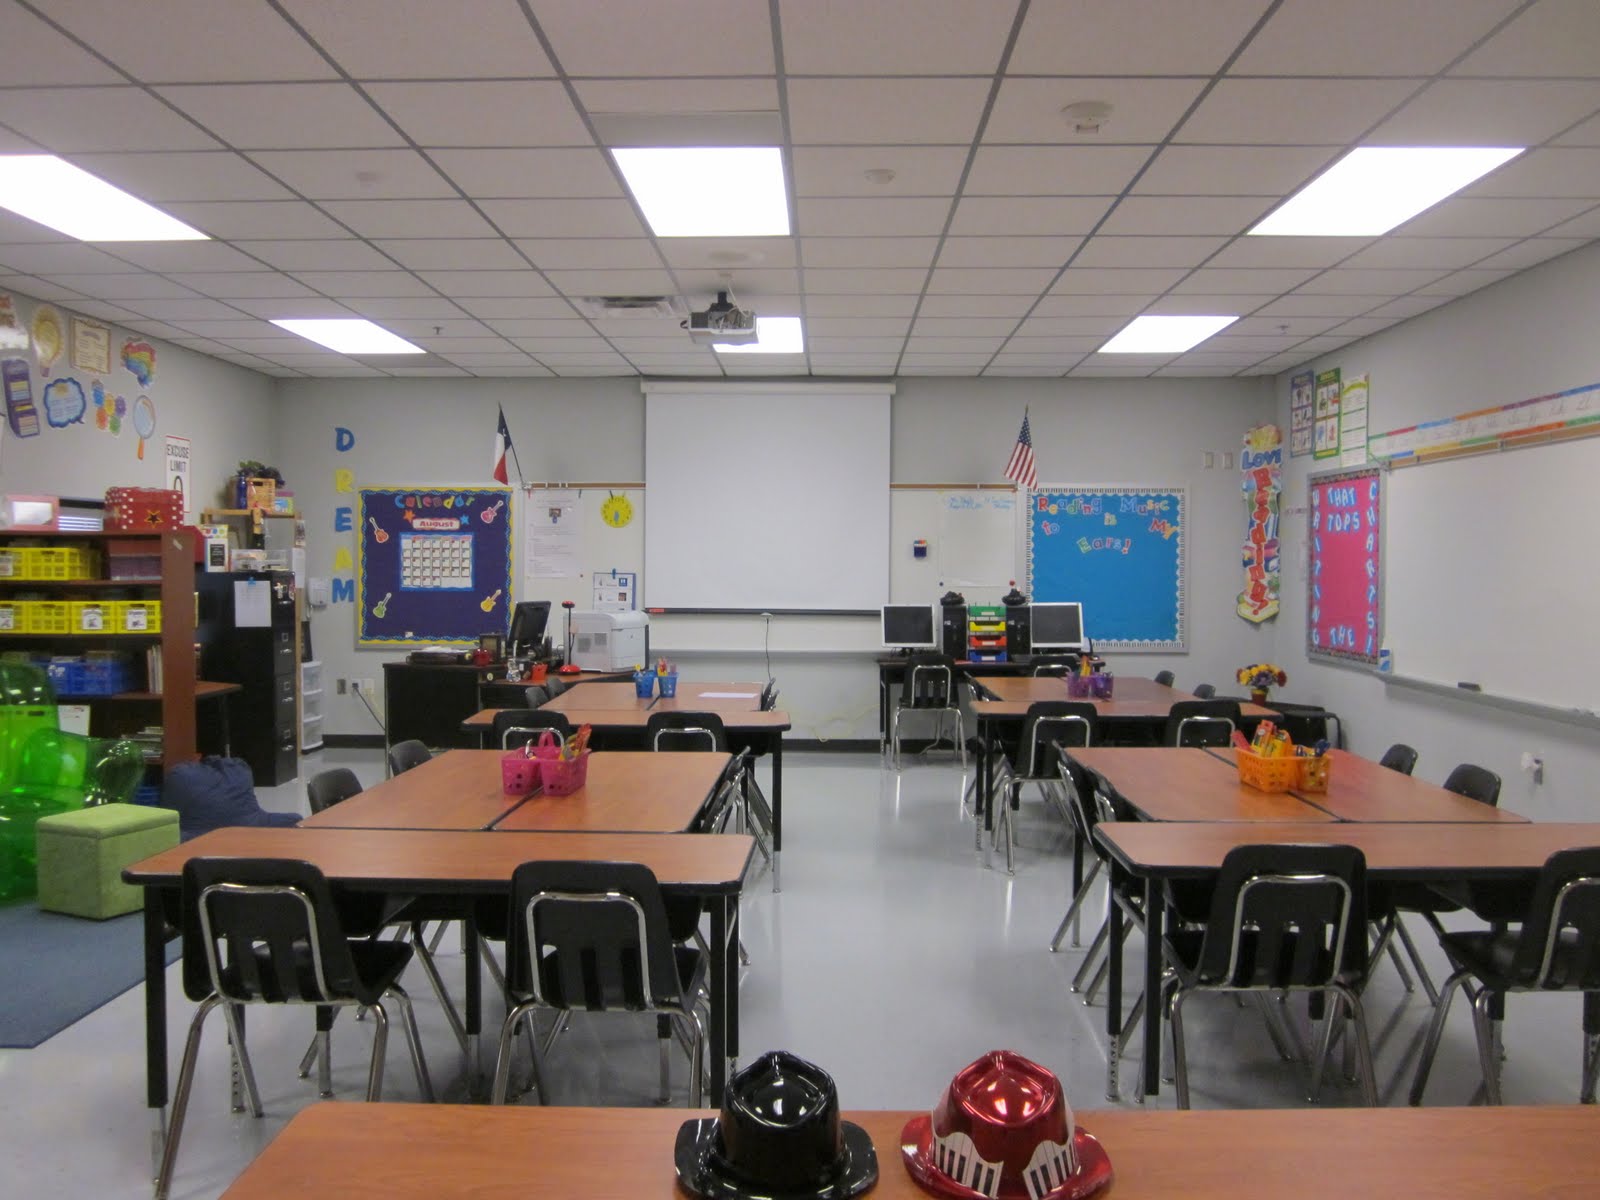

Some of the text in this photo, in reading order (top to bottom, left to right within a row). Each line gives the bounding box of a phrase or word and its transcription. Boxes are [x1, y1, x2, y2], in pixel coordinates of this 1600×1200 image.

[166, 443, 189, 459] EXCUSE
[169, 459, 187, 473] LIMIT
[395, 495, 475, 509] Calendar
[1037, 496, 1102, 515] Reading
[1120, 496, 1170, 515] Music
[1327, 486, 1357, 506] THAT
[332, 427, 355, 604] DREAM
[1327, 511, 1361, 532] TOPS
[1042, 517, 1179, 540] to My
[1076, 536, 1131, 554] Ears!
[1329, 624, 1355, 647] THE
